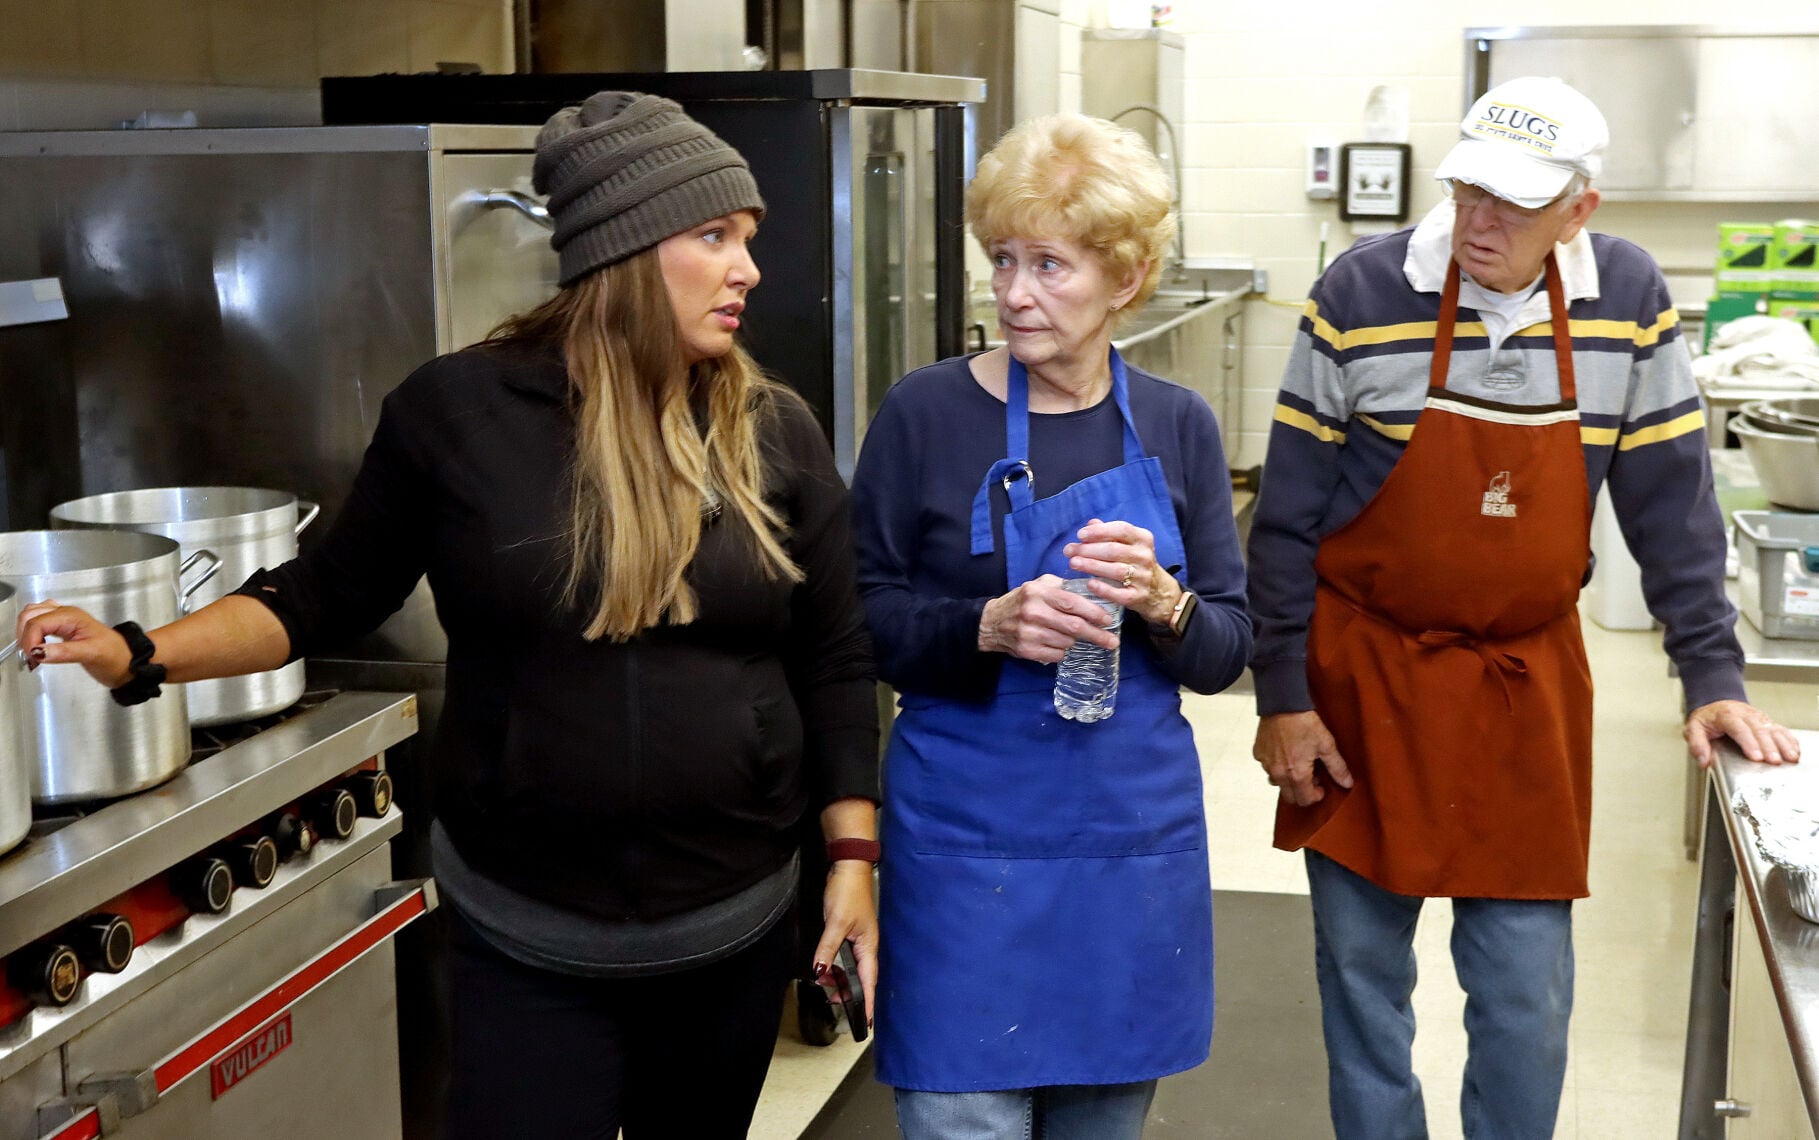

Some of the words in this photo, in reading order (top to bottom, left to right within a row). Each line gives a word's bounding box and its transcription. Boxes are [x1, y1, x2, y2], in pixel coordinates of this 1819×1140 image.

[1481, 106, 1559, 141] SLUGS
[1481, 502, 1517, 517] BEAR
[1483, 491, 1508, 504] BIG
[221, 1022, 287, 1087] VULCAN
